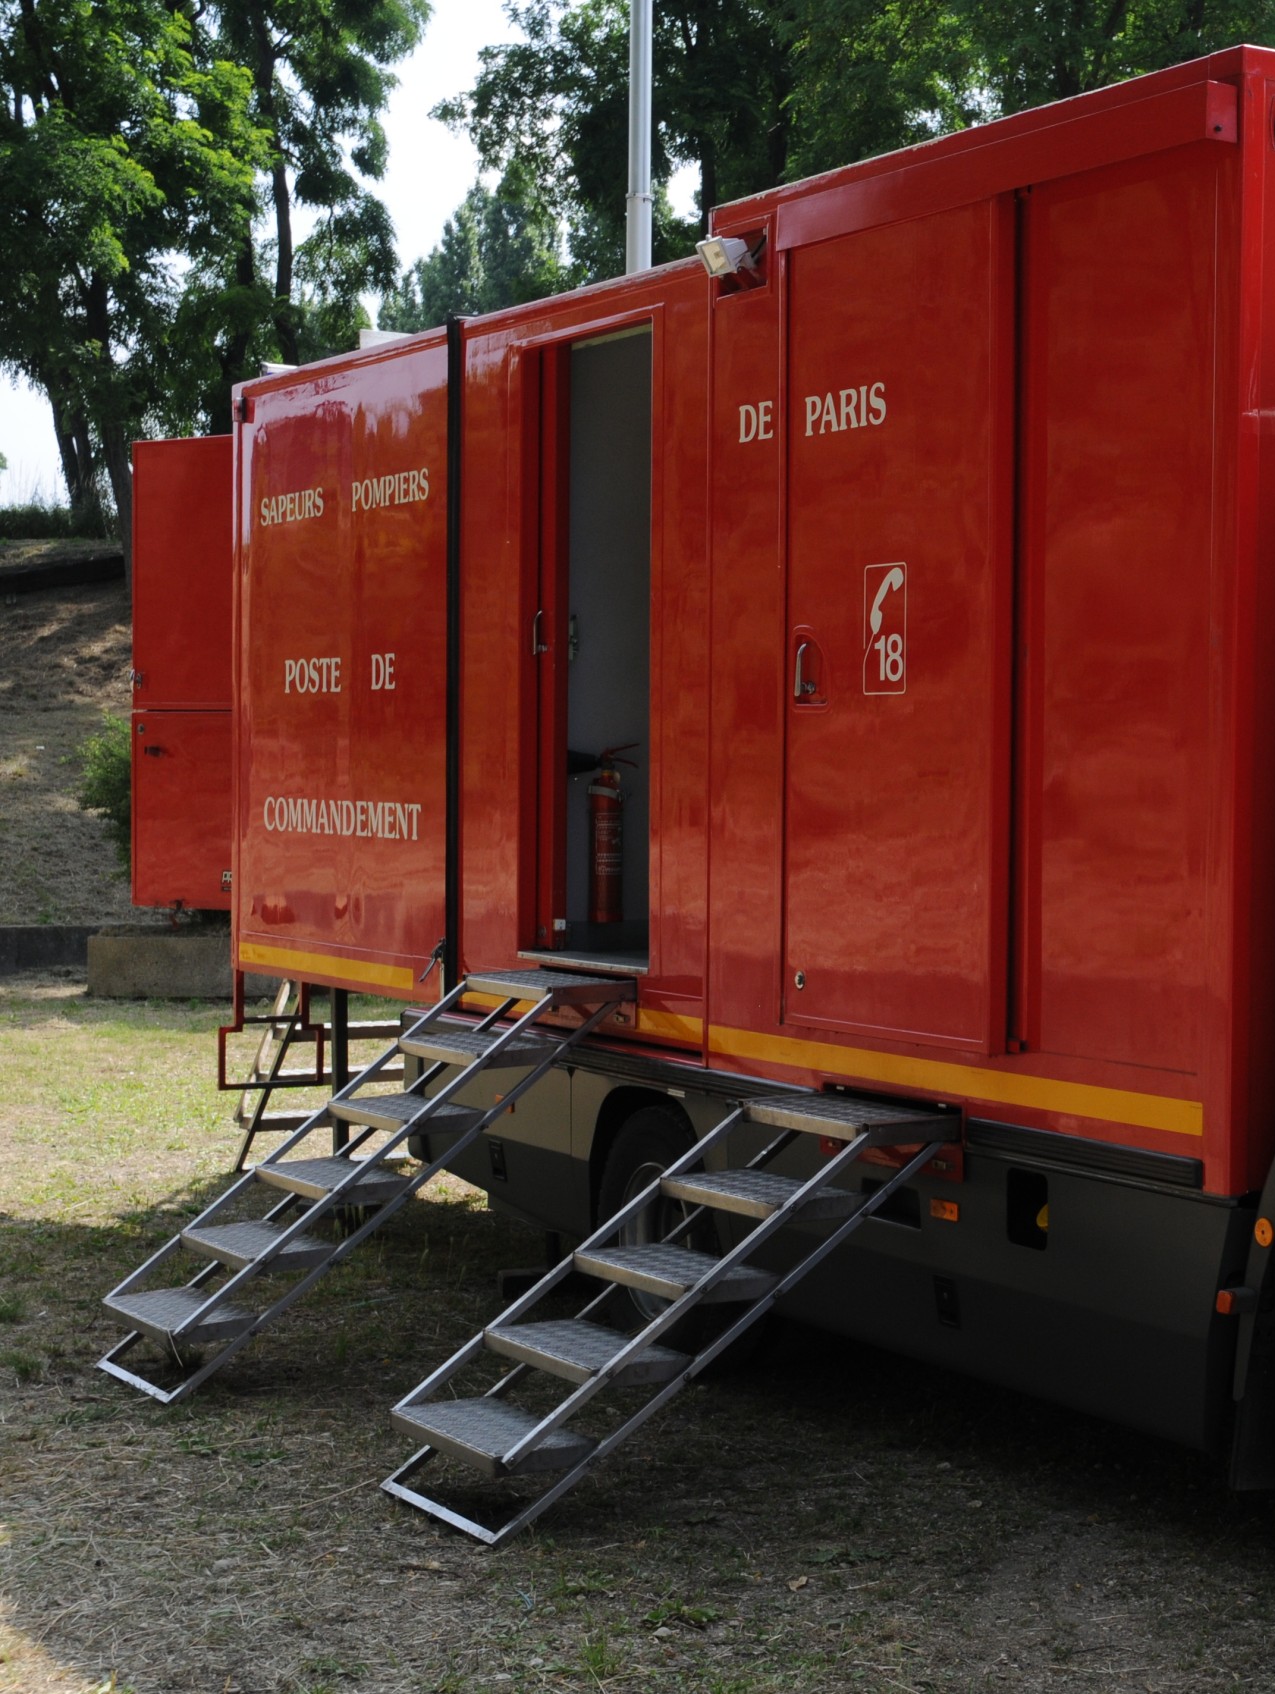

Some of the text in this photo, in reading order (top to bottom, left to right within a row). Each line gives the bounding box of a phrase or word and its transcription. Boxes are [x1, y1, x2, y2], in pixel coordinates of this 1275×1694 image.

[260, 381, 887, 527] SAPEURS POMPIERS DE PARIS
[284, 652, 396, 694] POSTE DE
[873, 633, 904, 682] 18
[263, 796, 422, 841] COMMANDEMENT
